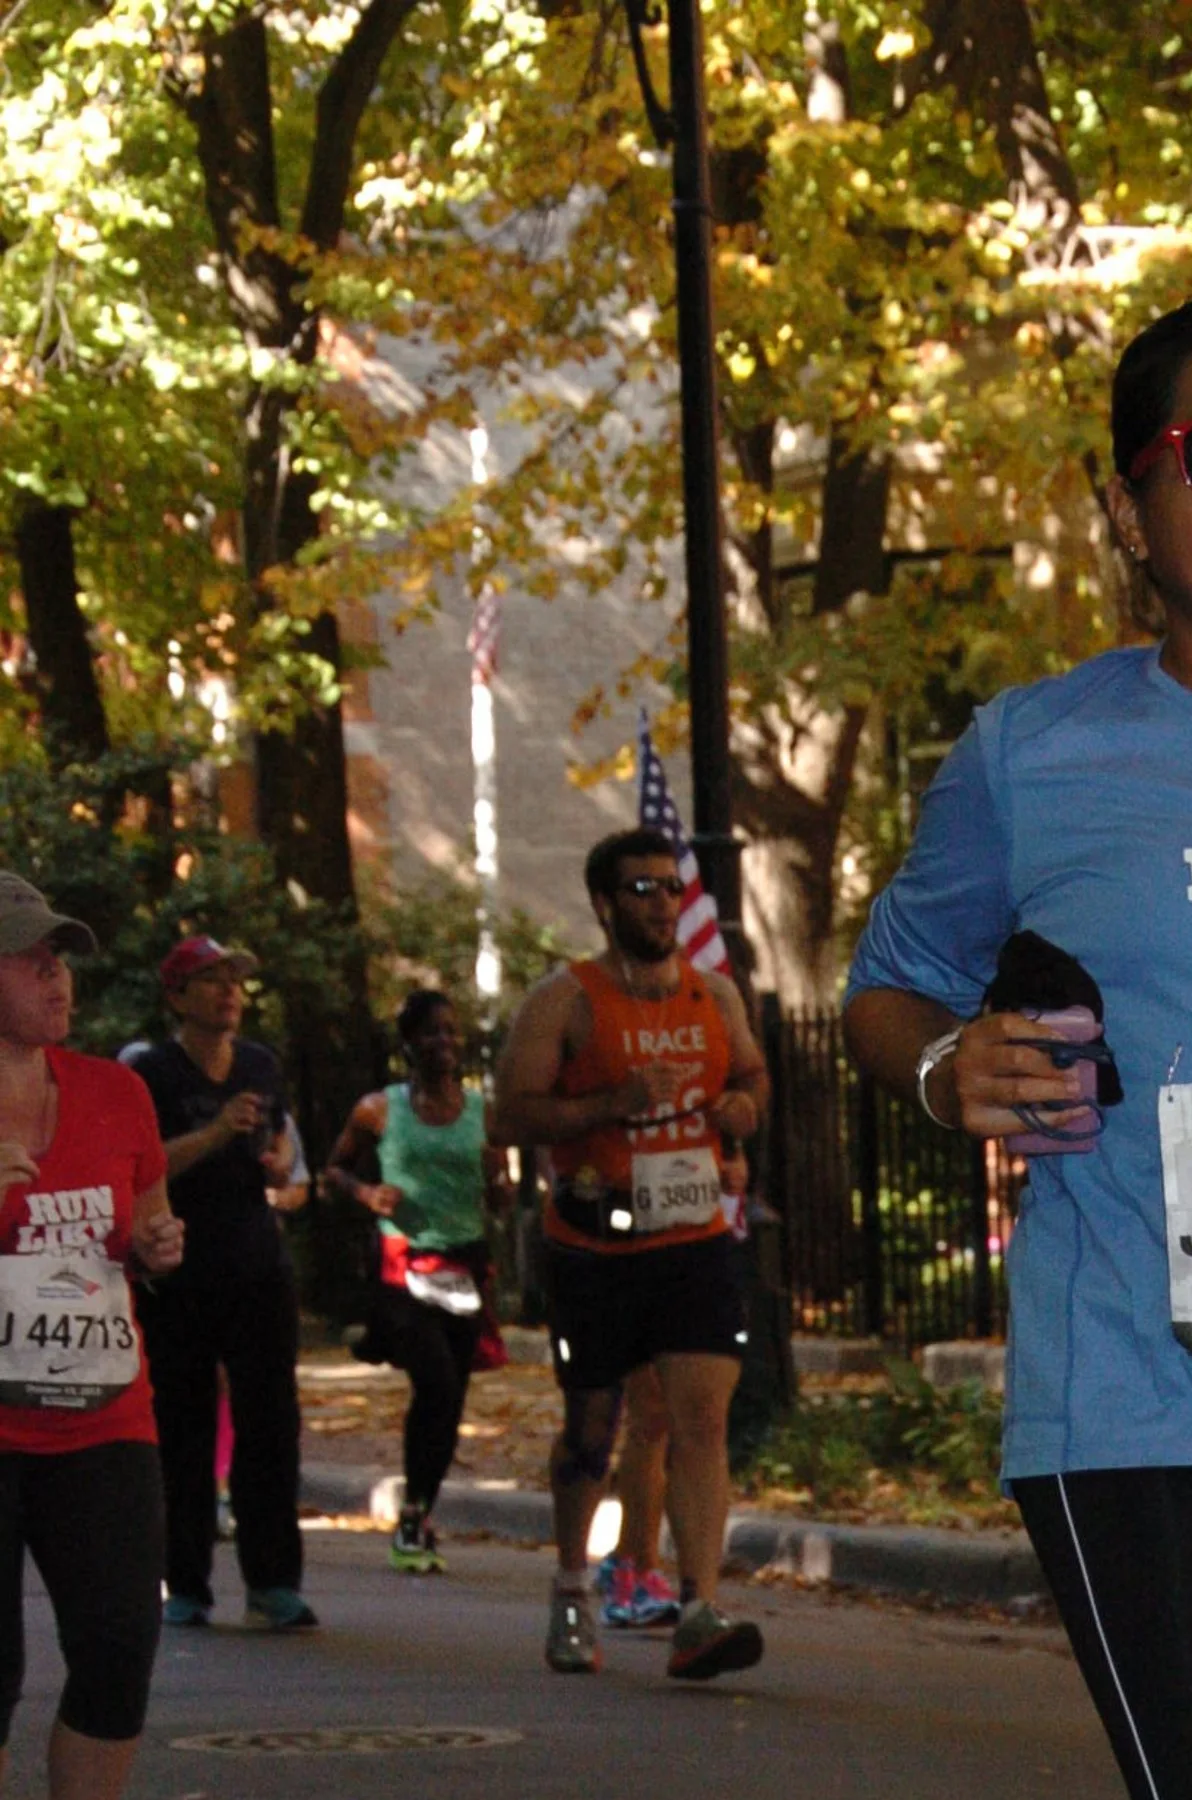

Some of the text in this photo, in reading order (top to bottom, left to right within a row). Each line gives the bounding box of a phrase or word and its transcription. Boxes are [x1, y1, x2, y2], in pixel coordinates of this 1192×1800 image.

[621, 1024, 708, 1055] I RACE
[25, 1185, 114, 1226] RUN
[0, 1312, 134, 1351] J 44713
